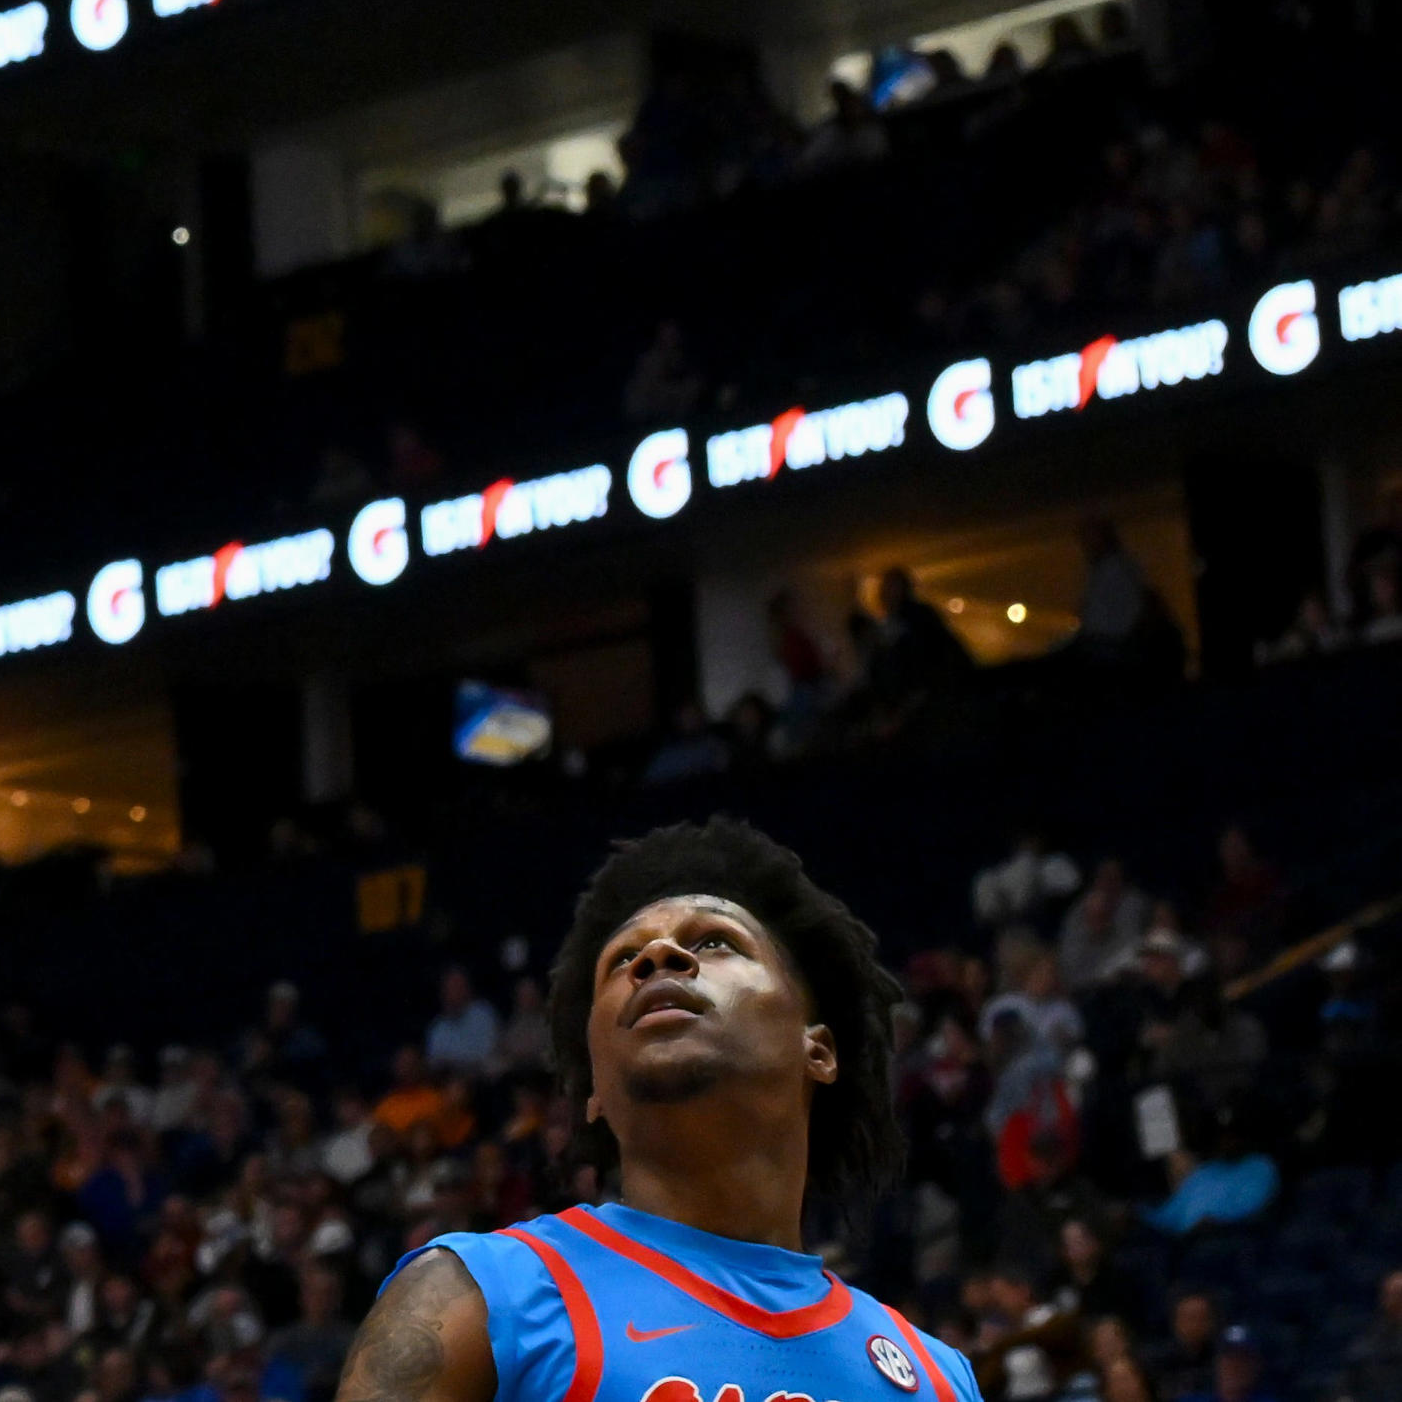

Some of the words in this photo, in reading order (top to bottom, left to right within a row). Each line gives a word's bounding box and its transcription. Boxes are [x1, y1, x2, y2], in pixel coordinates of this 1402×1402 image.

[87, 559, 145, 644] G
[348, 497, 409, 585] G
[627, 428, 692, 519] G
[927, 358, 995, 450] G
[1248, 280, 1320, 375] G
[871, 1338, 916, 1387] SEC
